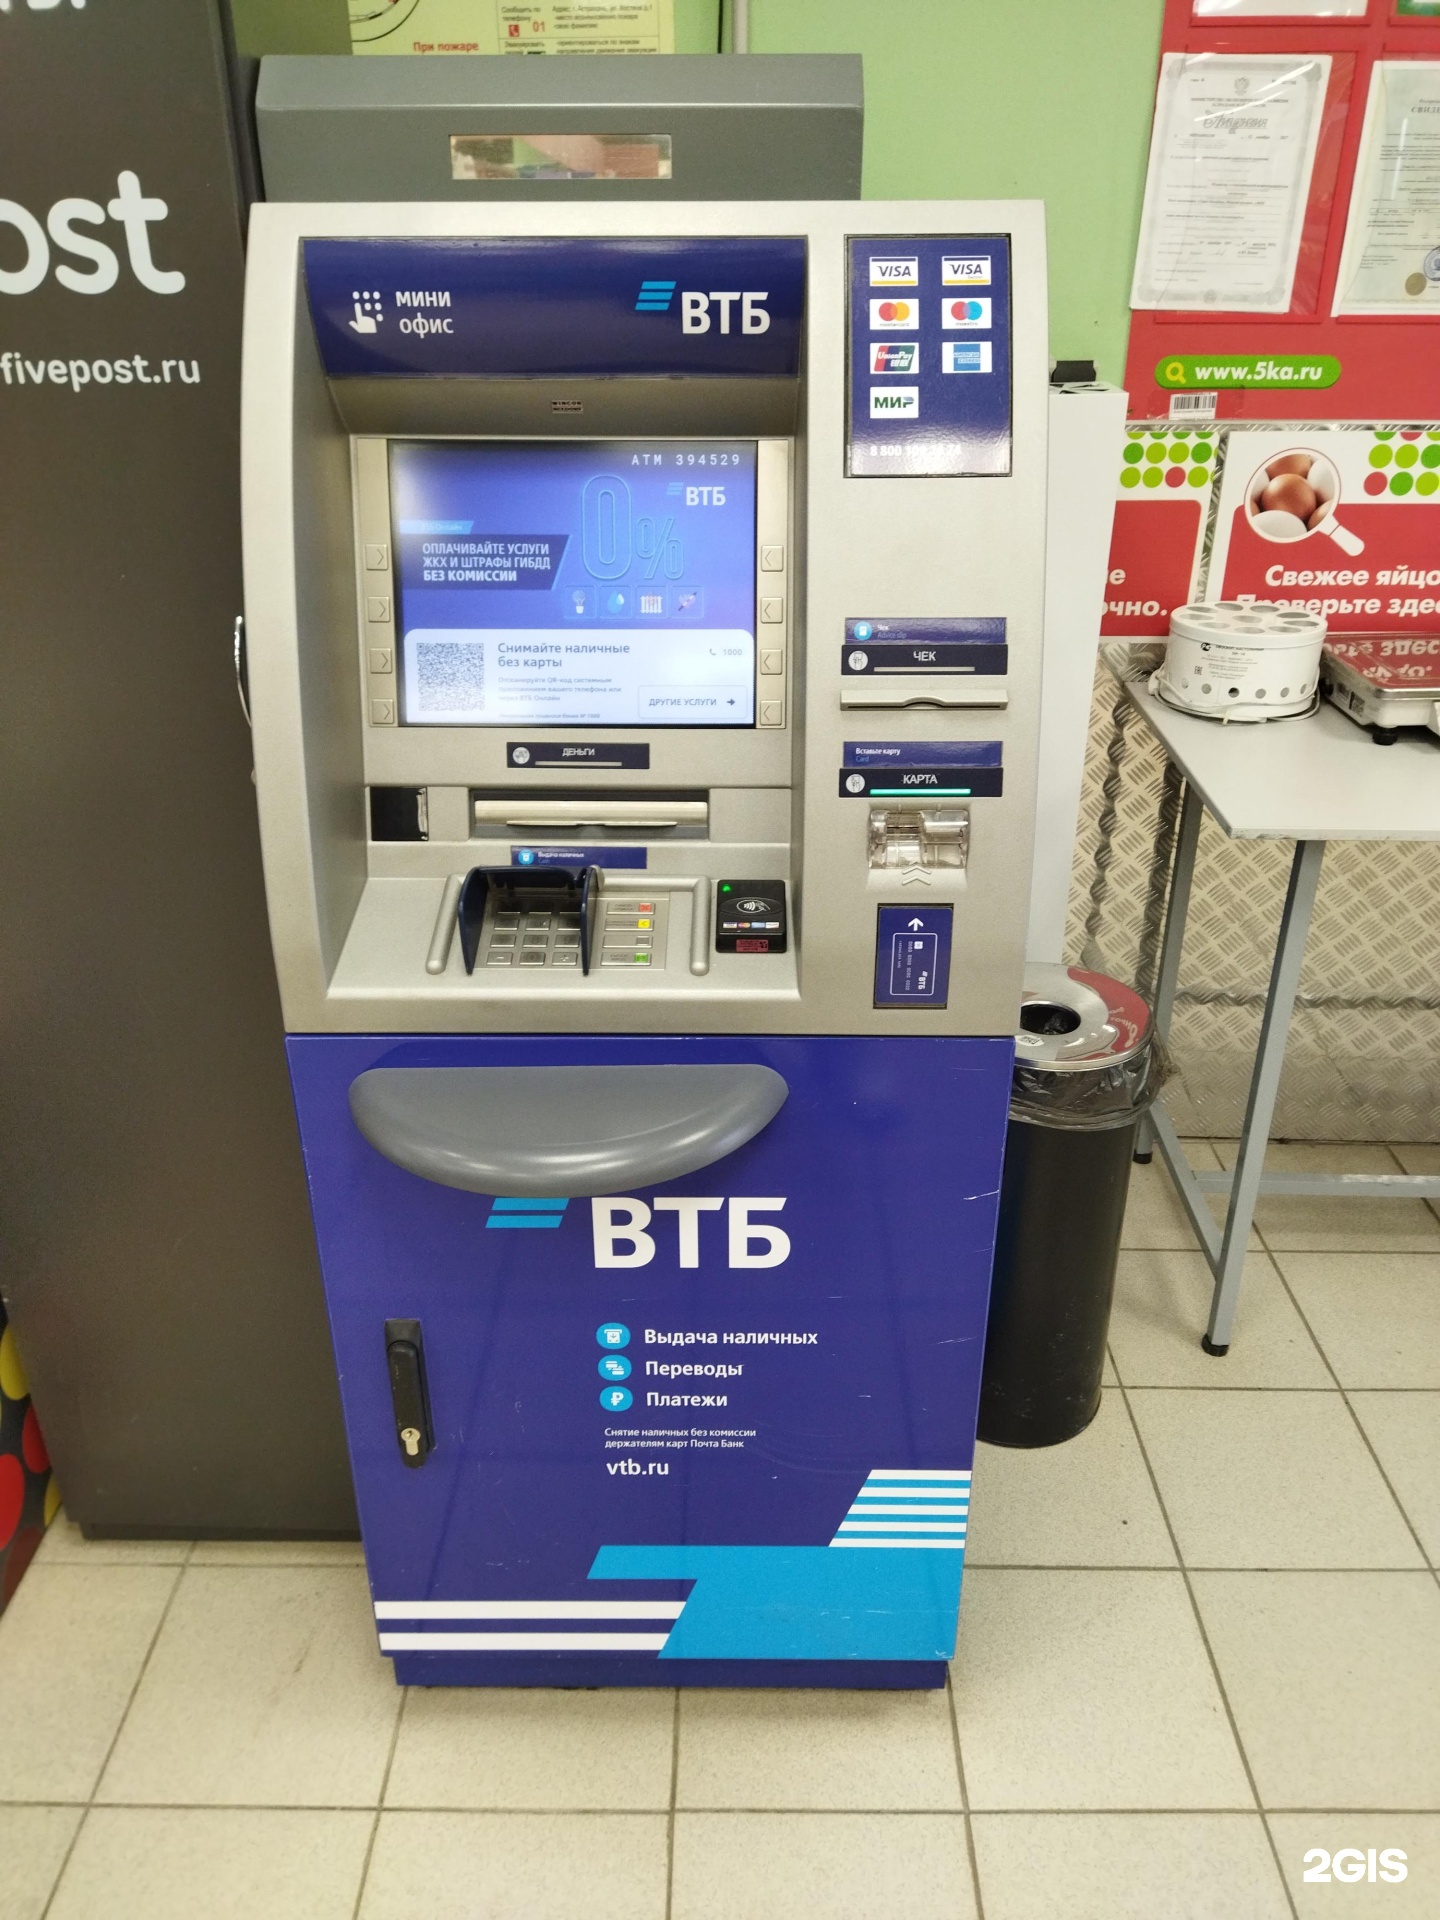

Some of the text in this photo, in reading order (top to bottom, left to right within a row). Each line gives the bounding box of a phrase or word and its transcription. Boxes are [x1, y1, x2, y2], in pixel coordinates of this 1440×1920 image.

[533, 21, 546, 32] 01
[413, 42, 479, 53] При пожаре
[876, 265, 911, 277] VISA
[949, 264, 983, 275] VISA
[681, 291, 771, 335] ВТБ
[399, 313, 454, 338] офис
[0, 352, 200, 392] fivepost.ru
[1194, 360, 1322, 381] www.5ka.ru
[874, 396, 915, 409] МИР
[869, 445, 878, 456] 8
[879, 445, 902, 456] 800
[631, 454, 740, 466] ATM 394529
[686, 486, 727, 506] ВТБ
[422, 541, 549, 555] ОПЛАЧИВАЙТЕ УСЛУГИ
[423, 556, 551, 570] ЖКХ И ШТРАФЫ ГИБДД
[423, 570, 517, 581] БЕЗ КОМИССИИ
[1265, 564, 1370, 587] Свежее
[497, 642, 630, 654] Снимайте наличные
[722, 648, 743, 656] 1000
[913, 651, 937, 661] ЧЕК
[497, 656, 562, 669] без карты
[648, 698, 717, 707] ДРУГИЕ УСЛУГИ
[562, 747, 595, 757] ДЕНЬГИ
[882, 748, 901, 756] карту
[902, 774, 938, 784] КАРТА
[918, 976, 926, 990] ВТБ
[591, 1197, 791, 1269] ВТБ
[644, 1329, 818, 1347] Выдача наличных
[645, 1361, 744, 1379] Переводы
[646, 1392, 728, 1407] Платежи
[604, 1428, 756, 1437] Снятие наличных без комиссии
[604, 1439, 744, 1449] держателям карт Почта Банк
[606, 1458, 669, 1475] vtb.ru
